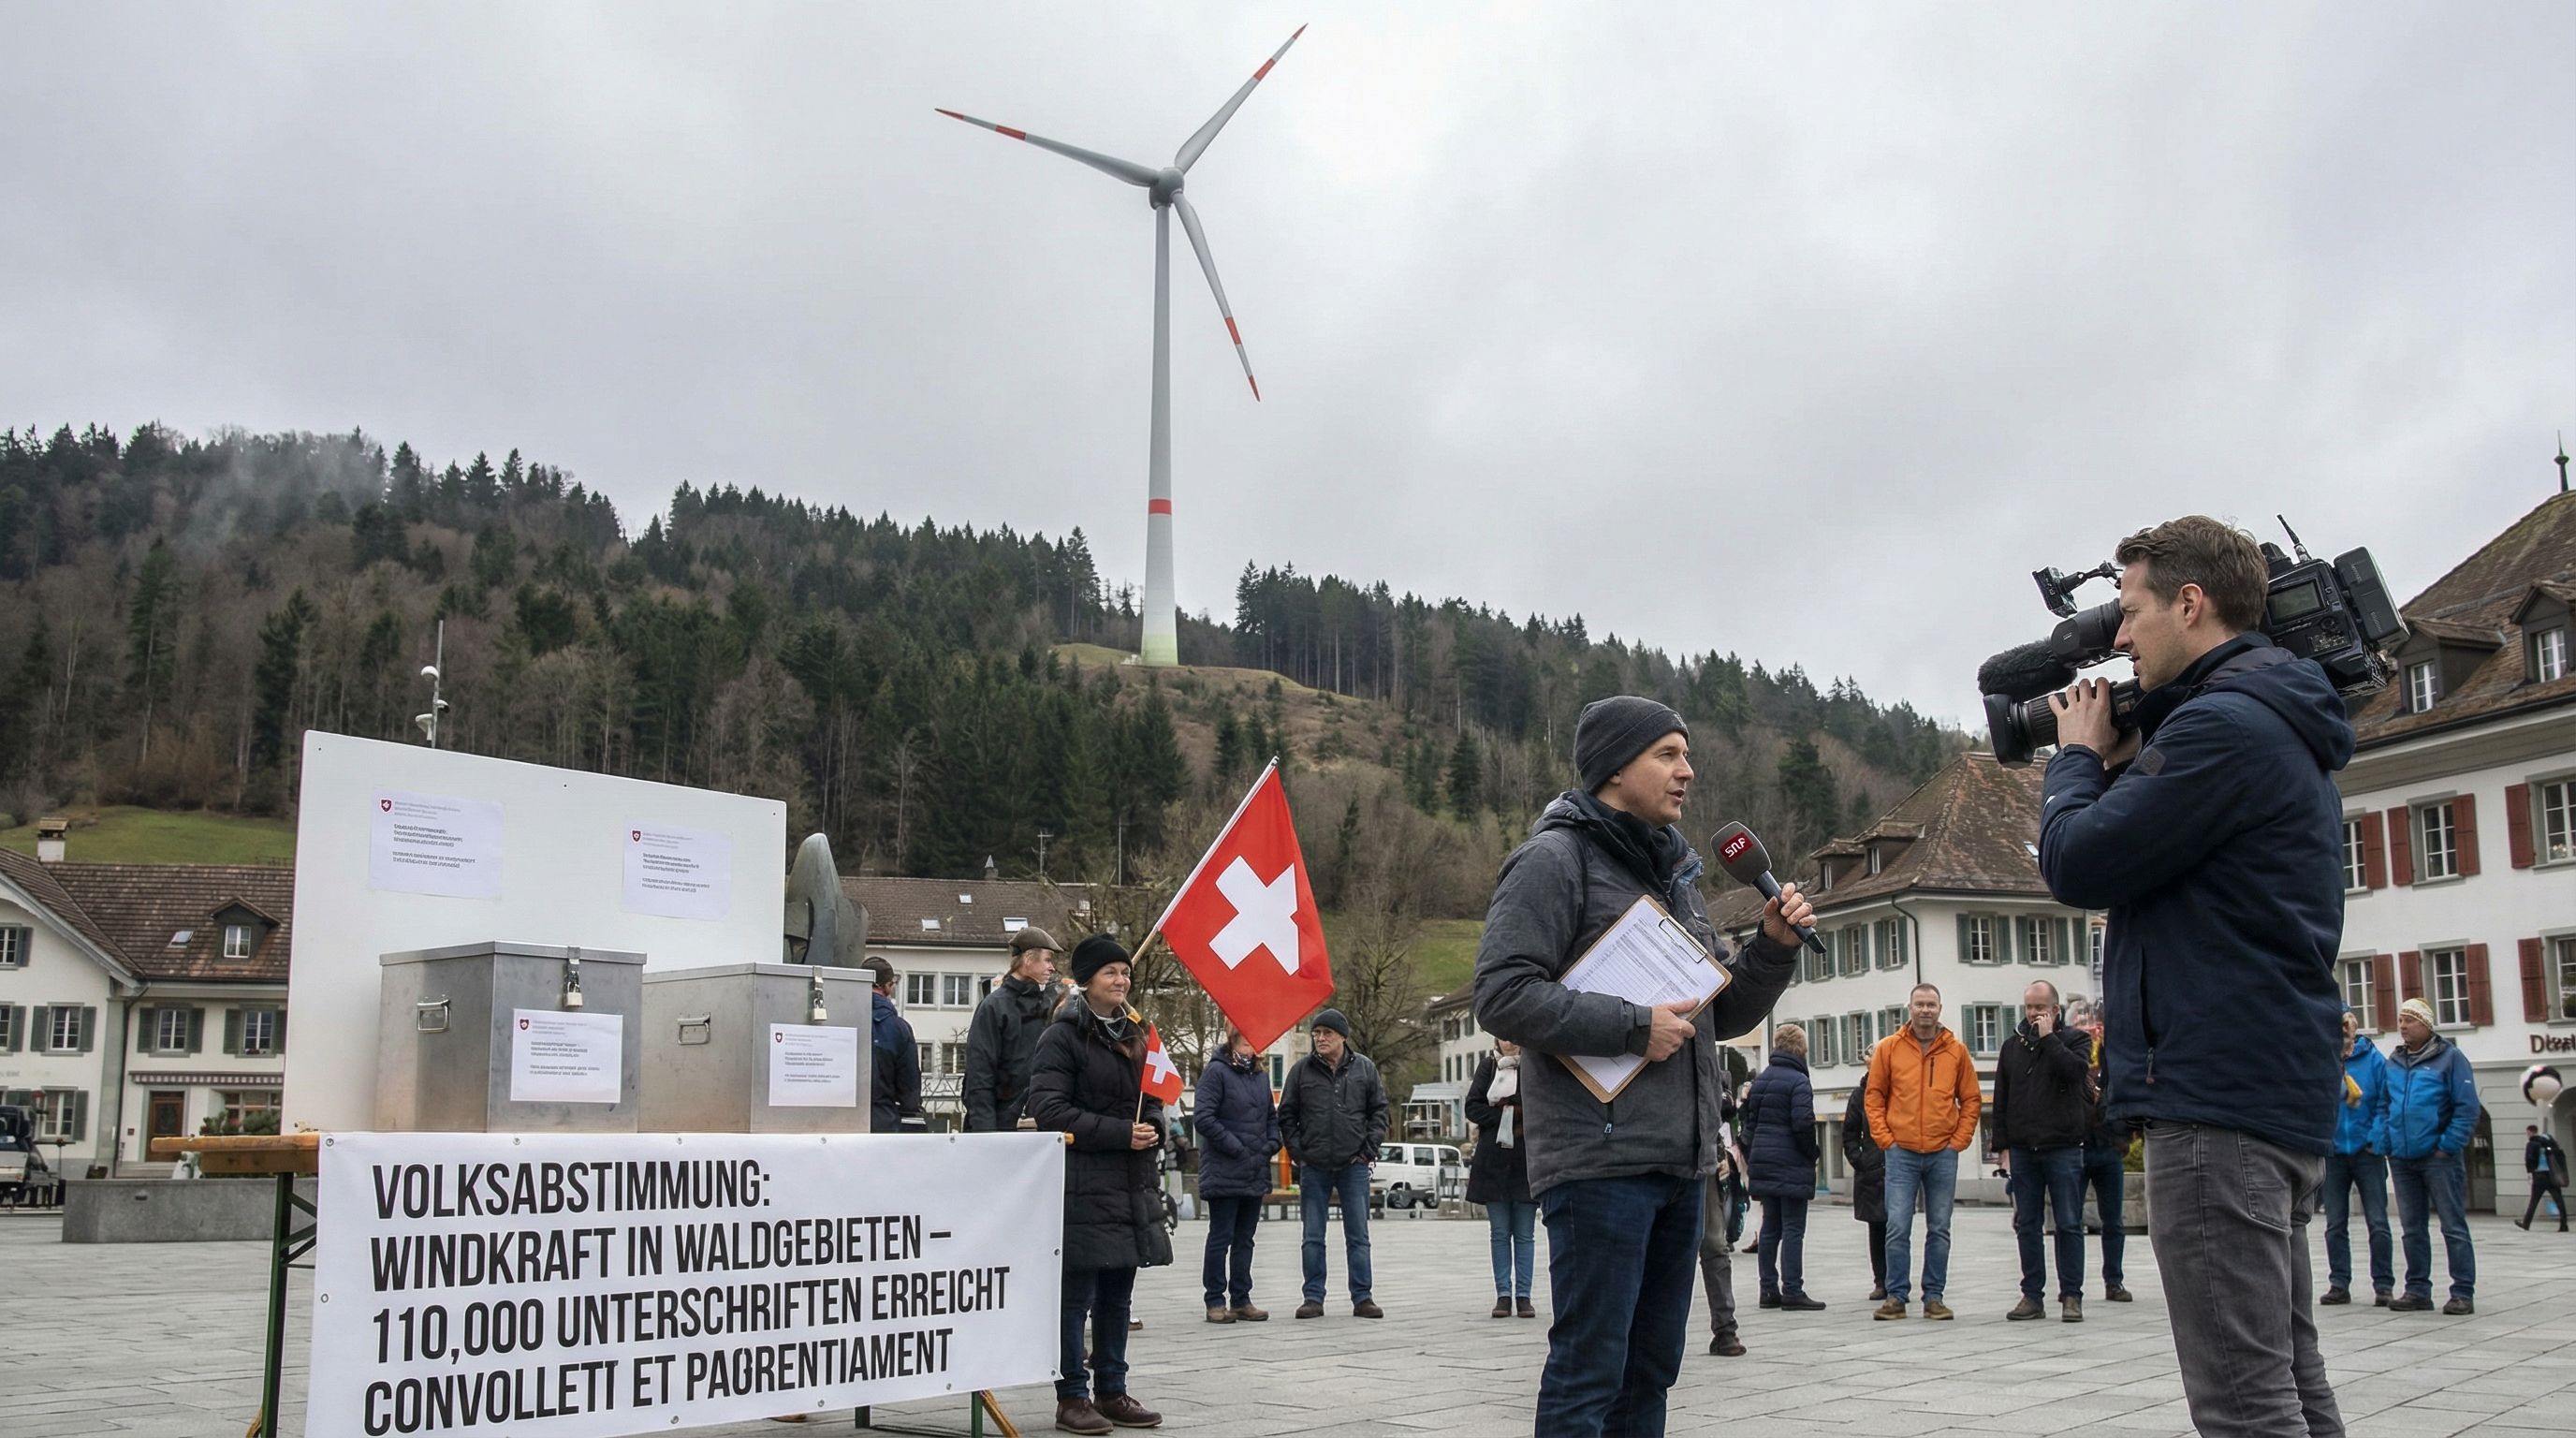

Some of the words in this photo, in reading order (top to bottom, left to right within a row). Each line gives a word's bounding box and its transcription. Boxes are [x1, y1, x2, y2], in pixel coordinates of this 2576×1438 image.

[373, 1160, 770, 1220] VOLKSABSTIMMUNG:
[371, 1227, 617, 1292] WINDKRAFT
[627, 1226, 663, 1277] IN
[674, 1214, 921, 1273] WALDGEBIETEN
[373, 1296, 545, 1365] 110,000
[557, 1277, 862, 1349] UNTERSCHRIFTEN
[871, 1266, 1010, 1324] ERREICHT
[633, 1354, 676, 1408] ET
